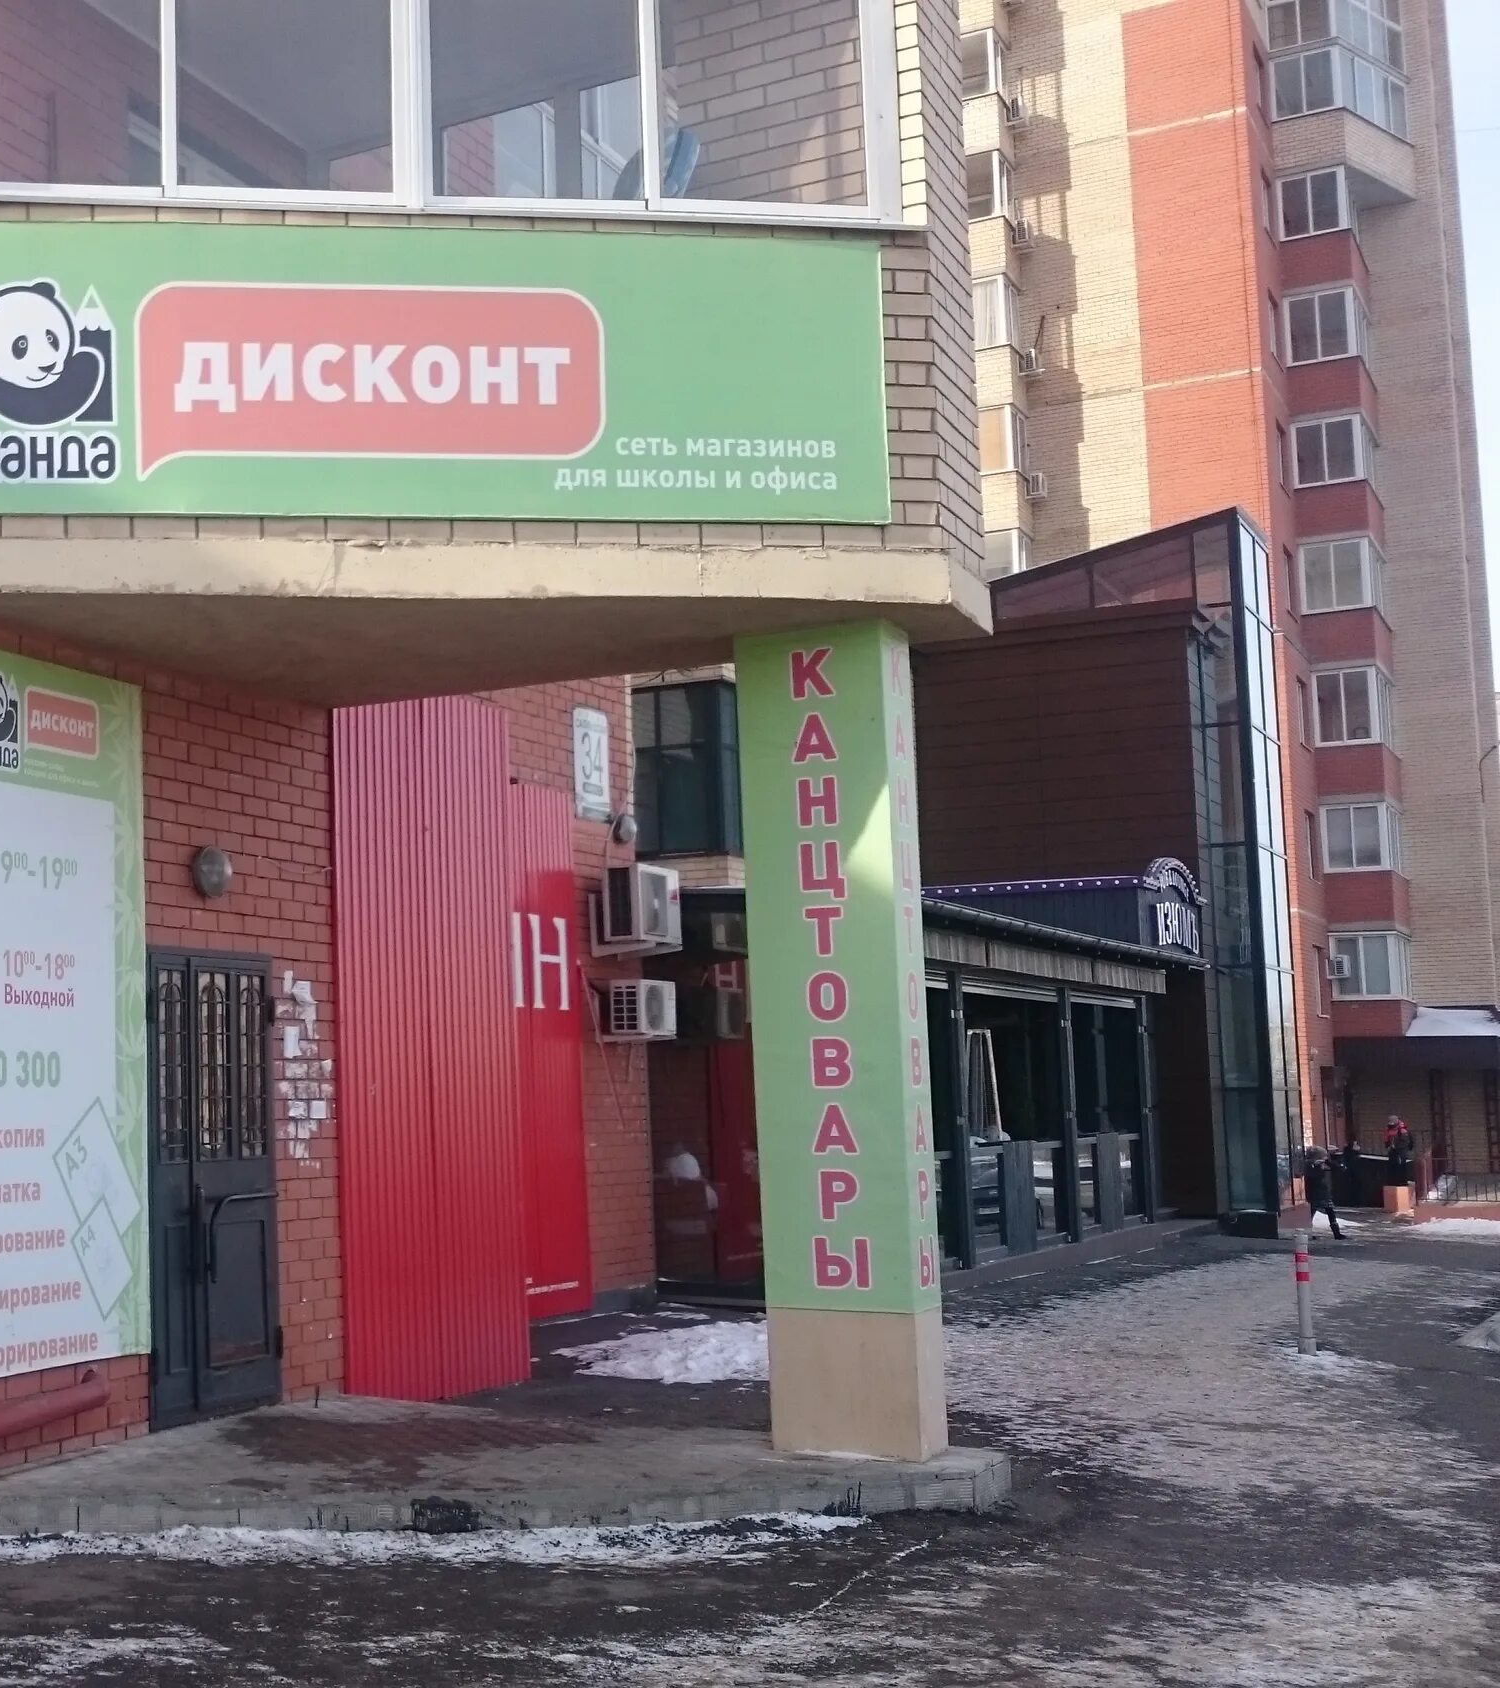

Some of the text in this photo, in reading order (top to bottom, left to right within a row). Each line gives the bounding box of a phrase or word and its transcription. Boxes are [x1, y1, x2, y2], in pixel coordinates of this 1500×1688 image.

[615, 436, 837, 458] сеть магазинов
[554, 465, 838, 495] для школы и офиса
[581, 731, 604, 784] 34
[789, 648, 871, 1290] КАНЦТОВАРЫ
[4, 983, 75, 1009] Выходной
[16, 1050, 61, 1088] 300
